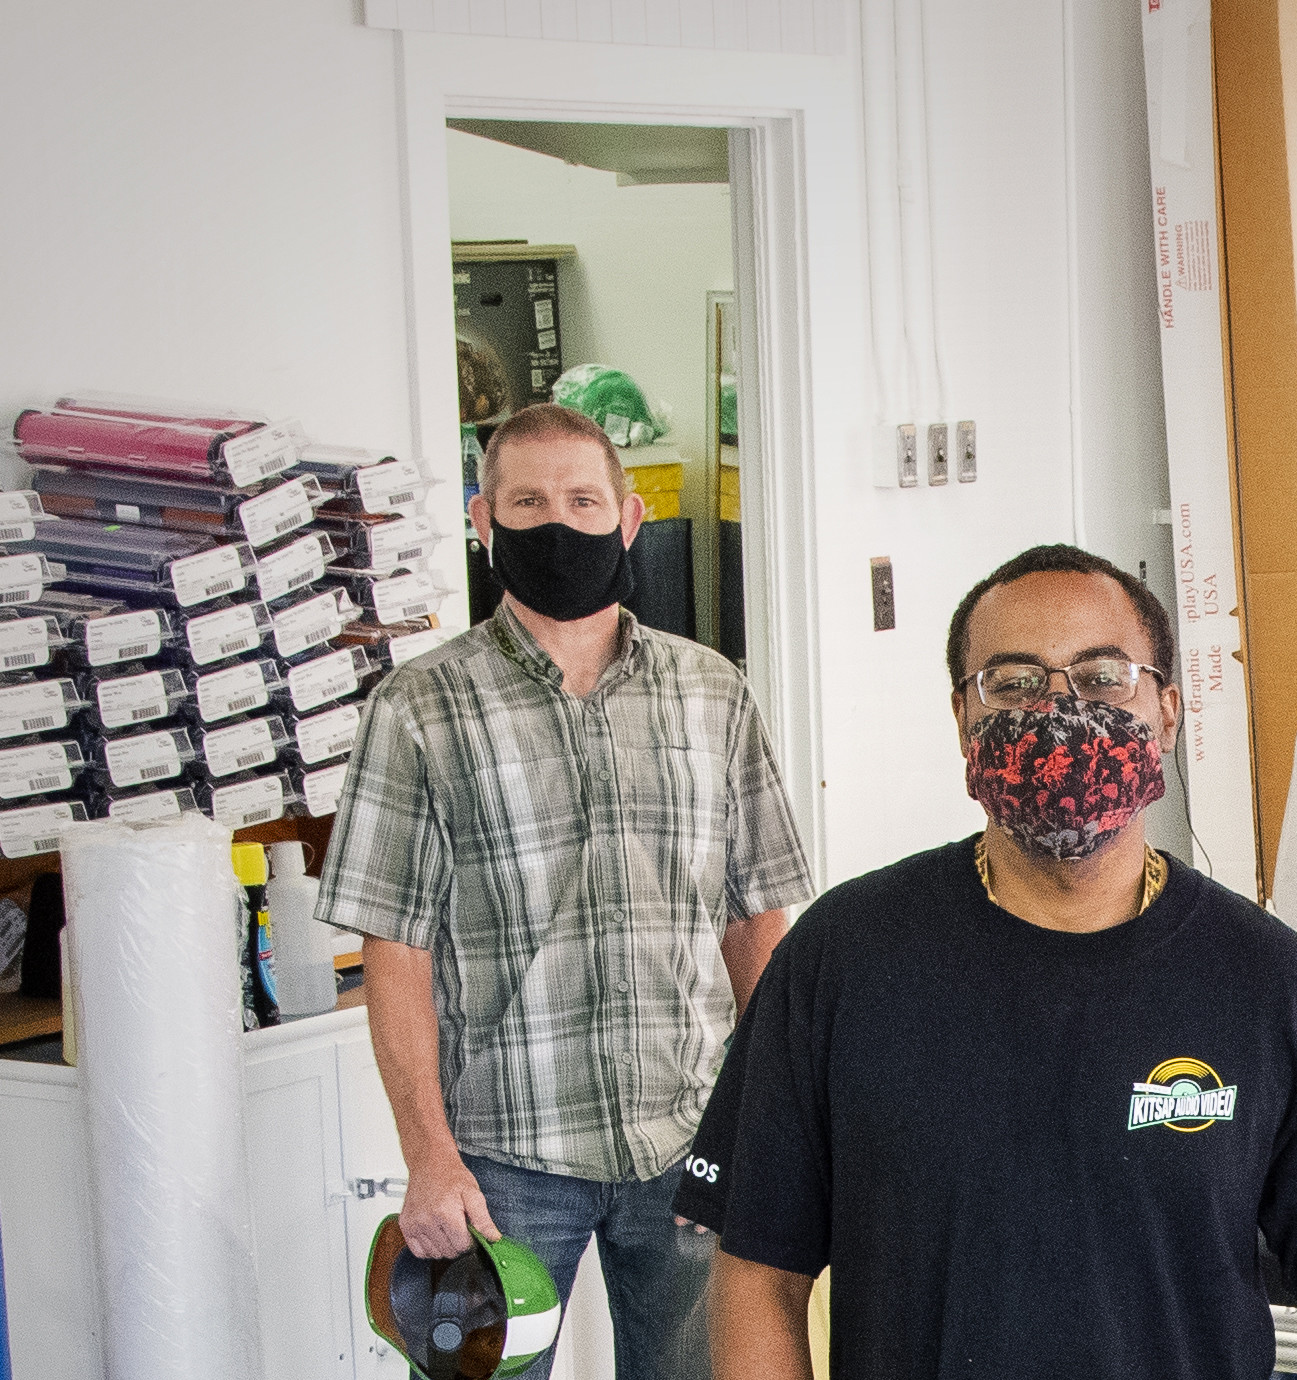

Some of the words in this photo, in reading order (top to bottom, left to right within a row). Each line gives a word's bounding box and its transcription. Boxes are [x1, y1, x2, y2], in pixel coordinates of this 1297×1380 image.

[1156, 186, 1168, 227] CARE
[1159, 230, 1171, 267] WITH
[1175, 224, 1185, 276] WARNING
[1161, 270, 1174, 329] HANDLE
[1203, 574, 1219, 616] USA
[1209, 644, 1224, 692] Made
[1133, 1096, 1175, 1125] KITSAP
[1174, 1096, 1200, 1117] AUDIO
[1201, 1089, 1234, 1117] VIDEO
